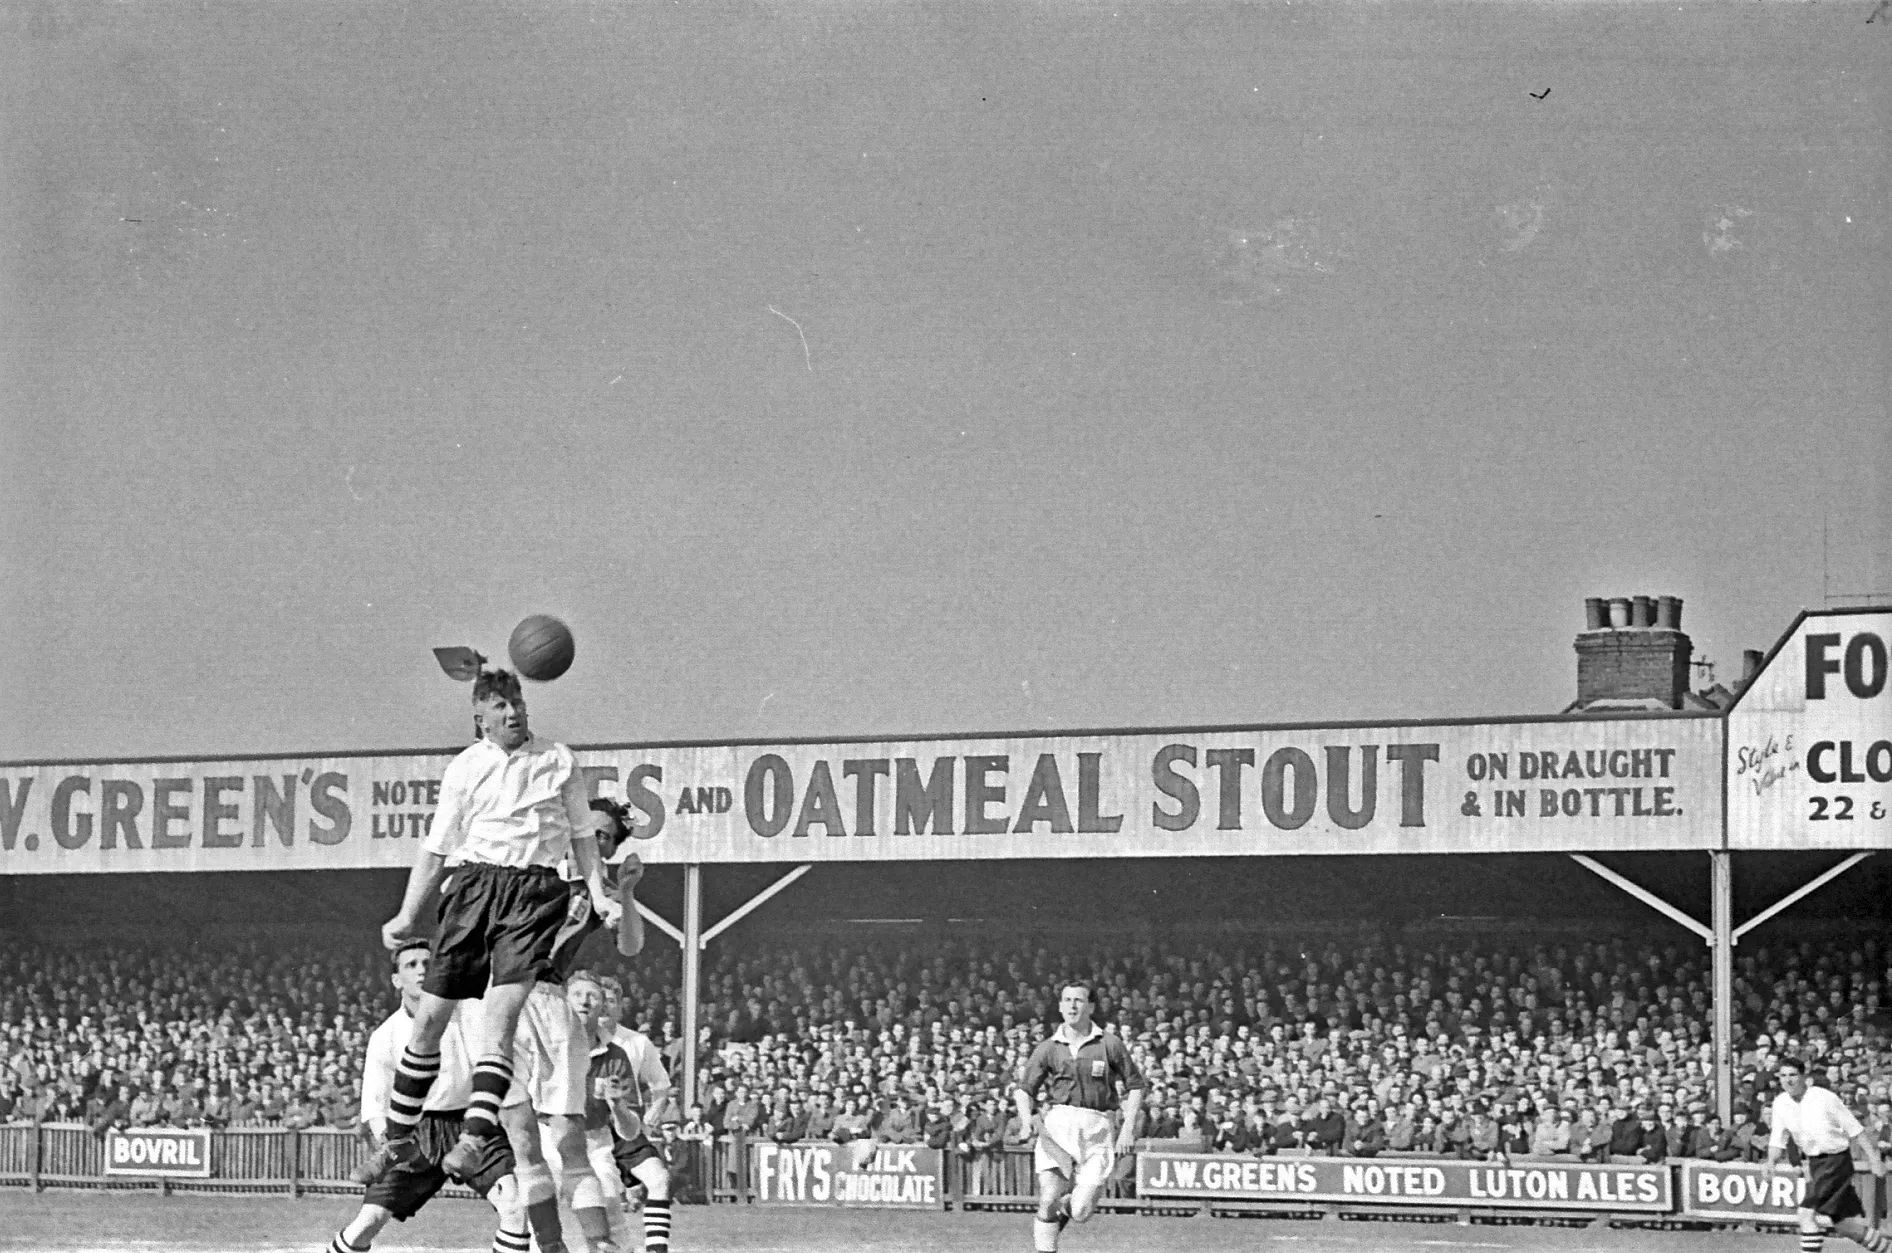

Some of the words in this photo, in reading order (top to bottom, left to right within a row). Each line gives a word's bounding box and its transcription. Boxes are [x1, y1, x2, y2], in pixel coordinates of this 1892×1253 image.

[1805, 632, 1892, 700] FO
[1467, 752, 1508, 780] ON
[1519, 748, 1676, 780] DRAUGHT
[1806, 740, 1892, 783] CLO
[676, 786, 732, 815] AND
[744, 752, 1124, 838] OATMEAL
[1152, 744, 1440, 832] STOUT
[1460, 791, 1482, 817] &
[1494, 790, 1526, 817] IN
[1540, 786, 1683, 817] BOTTLE.
[1808, 796, 1854, 820] 22
[1870, 801, 1886, 819] &
[114, 1137, 200, 1166] BOVRIL
[834, 1171, 935, 1203] CHOCOLATE
[1343, 1164, 1446, 1196] NOTED
[1469, 1168, 1569, 1200] LUTON
[1577, 1171, 1659, 1202] ALES
